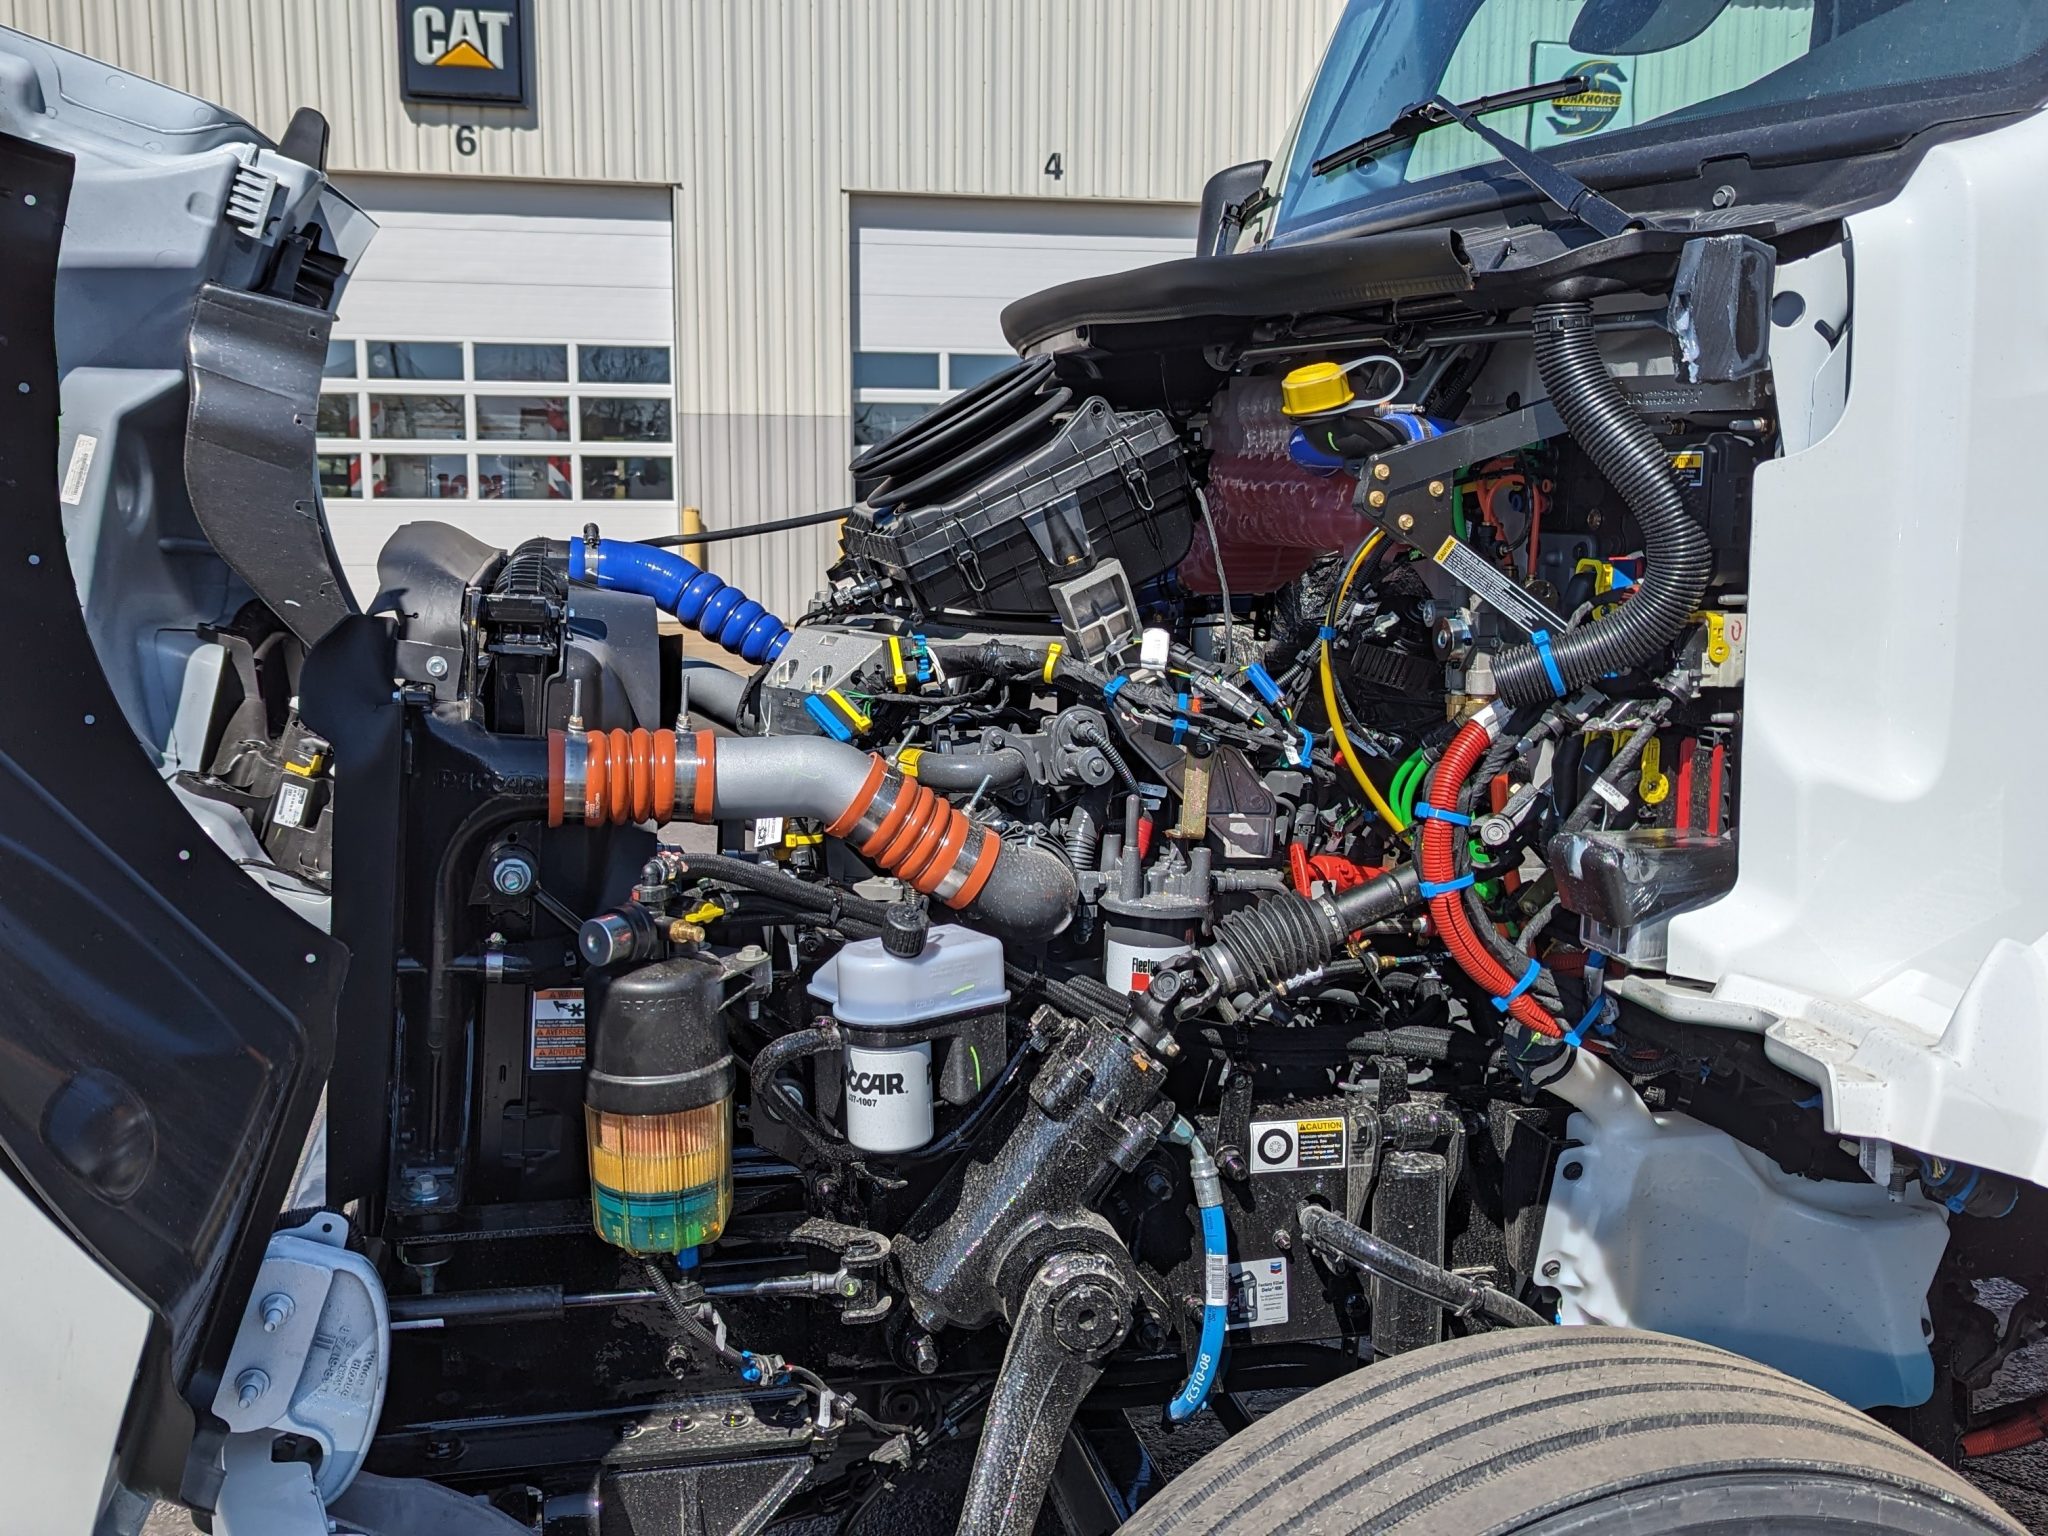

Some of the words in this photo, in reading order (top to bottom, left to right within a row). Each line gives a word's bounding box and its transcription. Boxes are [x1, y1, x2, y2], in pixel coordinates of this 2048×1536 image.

[413, 6, 511, 70] CAT
[456, 125, 477, 156] 6
[1044, 153, 1064, 180] 4
[1437, 540, 1455, 561] CAUTION
[847, 1069, 904, 1095] CCAR
[1306, 1122, 1342, 1130] CAUTION
[1186, 1353, 1211, 1404] FC510-08
